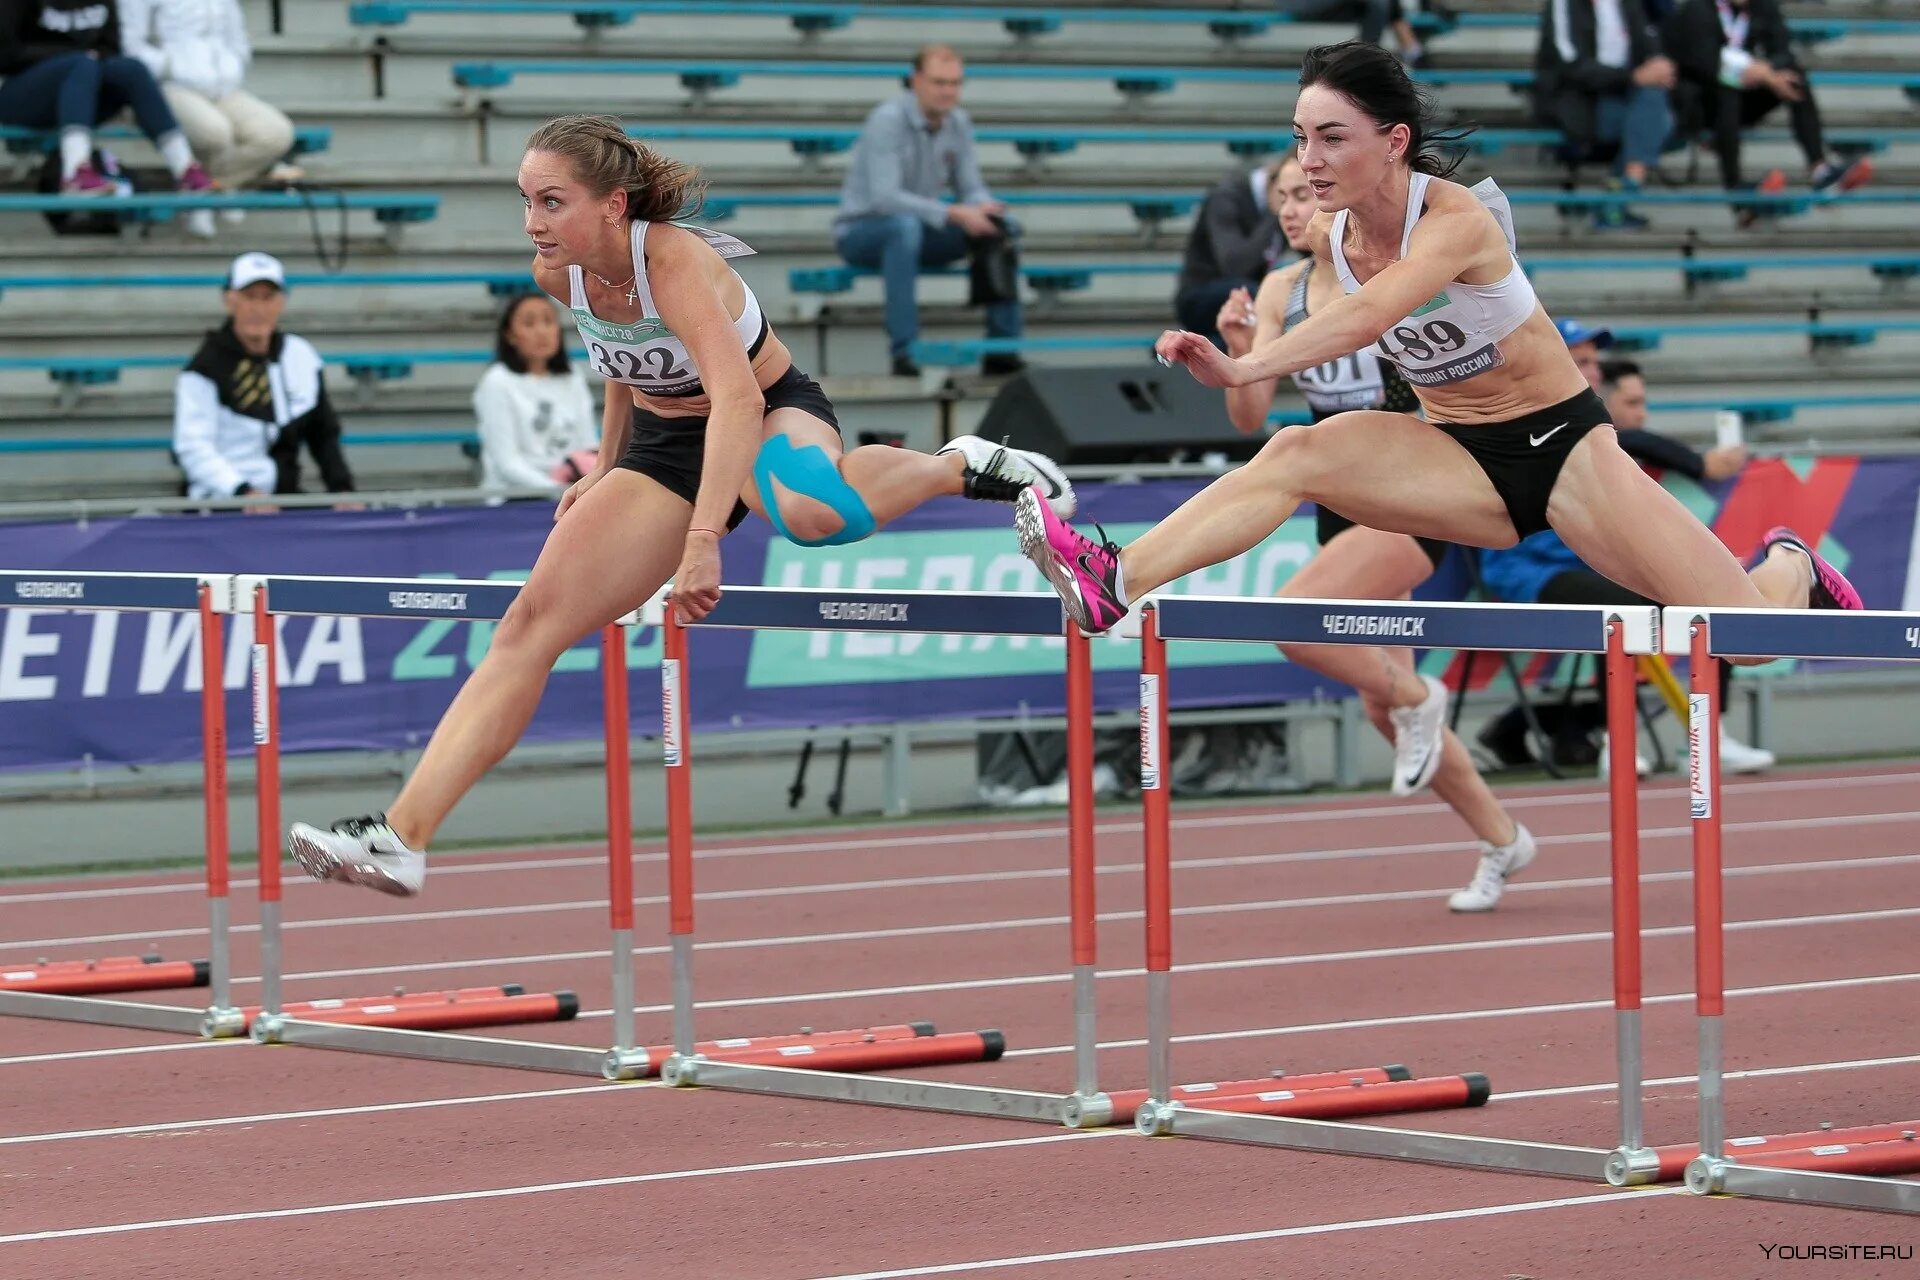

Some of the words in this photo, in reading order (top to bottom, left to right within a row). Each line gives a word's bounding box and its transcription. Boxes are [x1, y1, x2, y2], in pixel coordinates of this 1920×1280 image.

[592, 342, 690, 380] 322
[1447, 351, 1493, 378] РОССИИ
[819, 601, 909, 621] ЧЕЛЯБИНСК
[1322, 614, 1426, 637] ЧЕЛЯБИНСК
[1689, 725, 1703, 796] polanik
